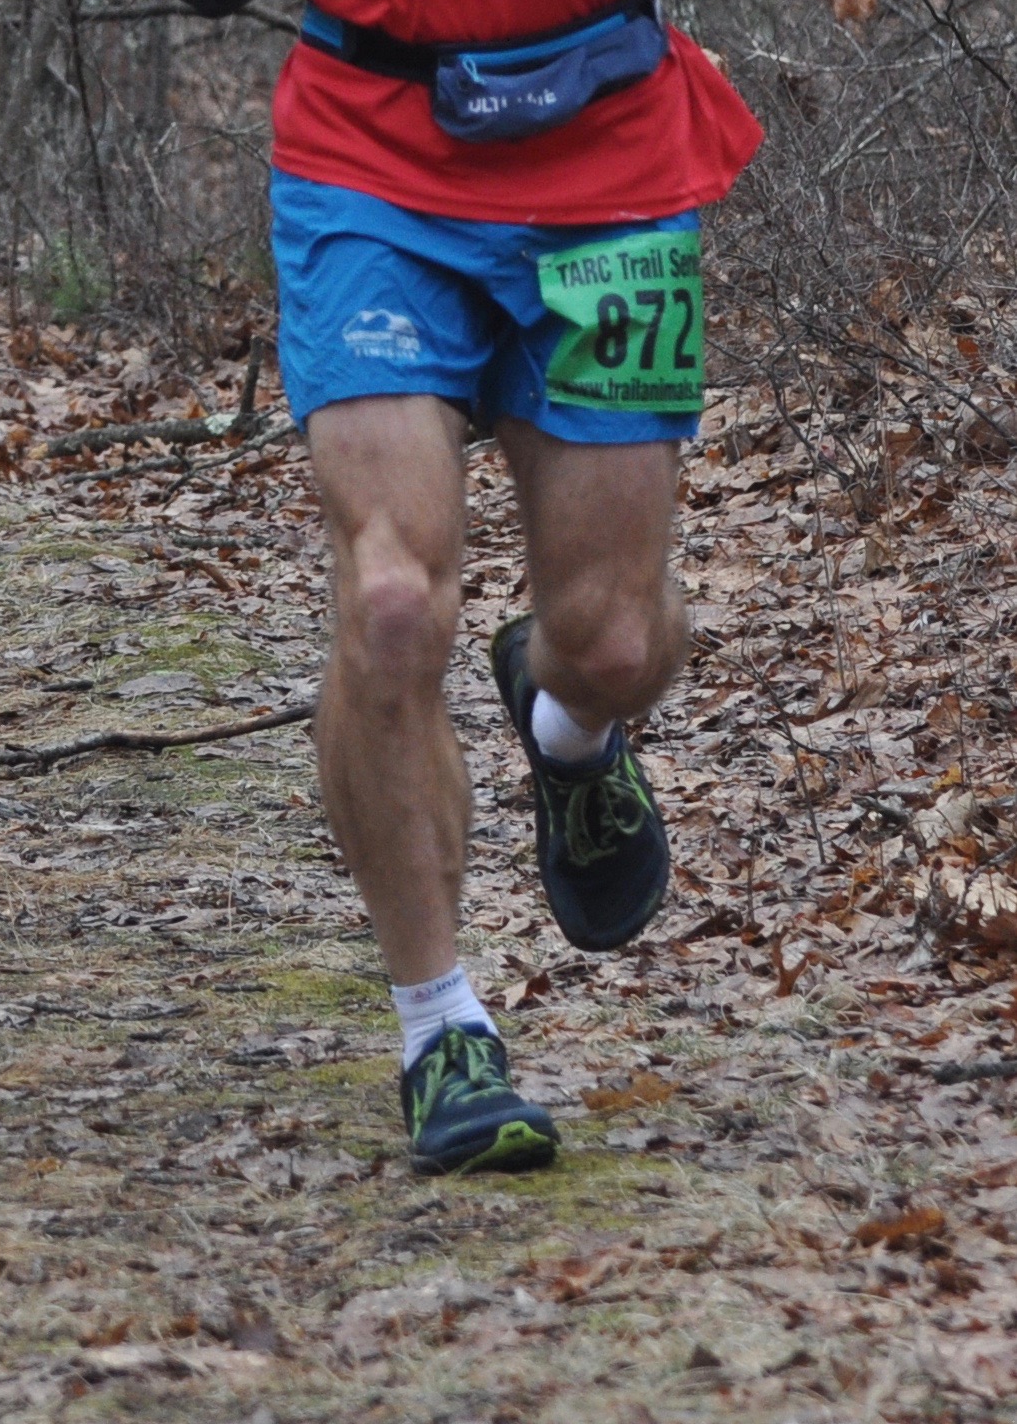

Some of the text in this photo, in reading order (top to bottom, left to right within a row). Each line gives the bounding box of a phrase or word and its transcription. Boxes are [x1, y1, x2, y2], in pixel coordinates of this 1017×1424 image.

[556, 254, 613, 288] TARC
[617, 248, 665, 281] Trail
[594, 289, 697, 370] 872
